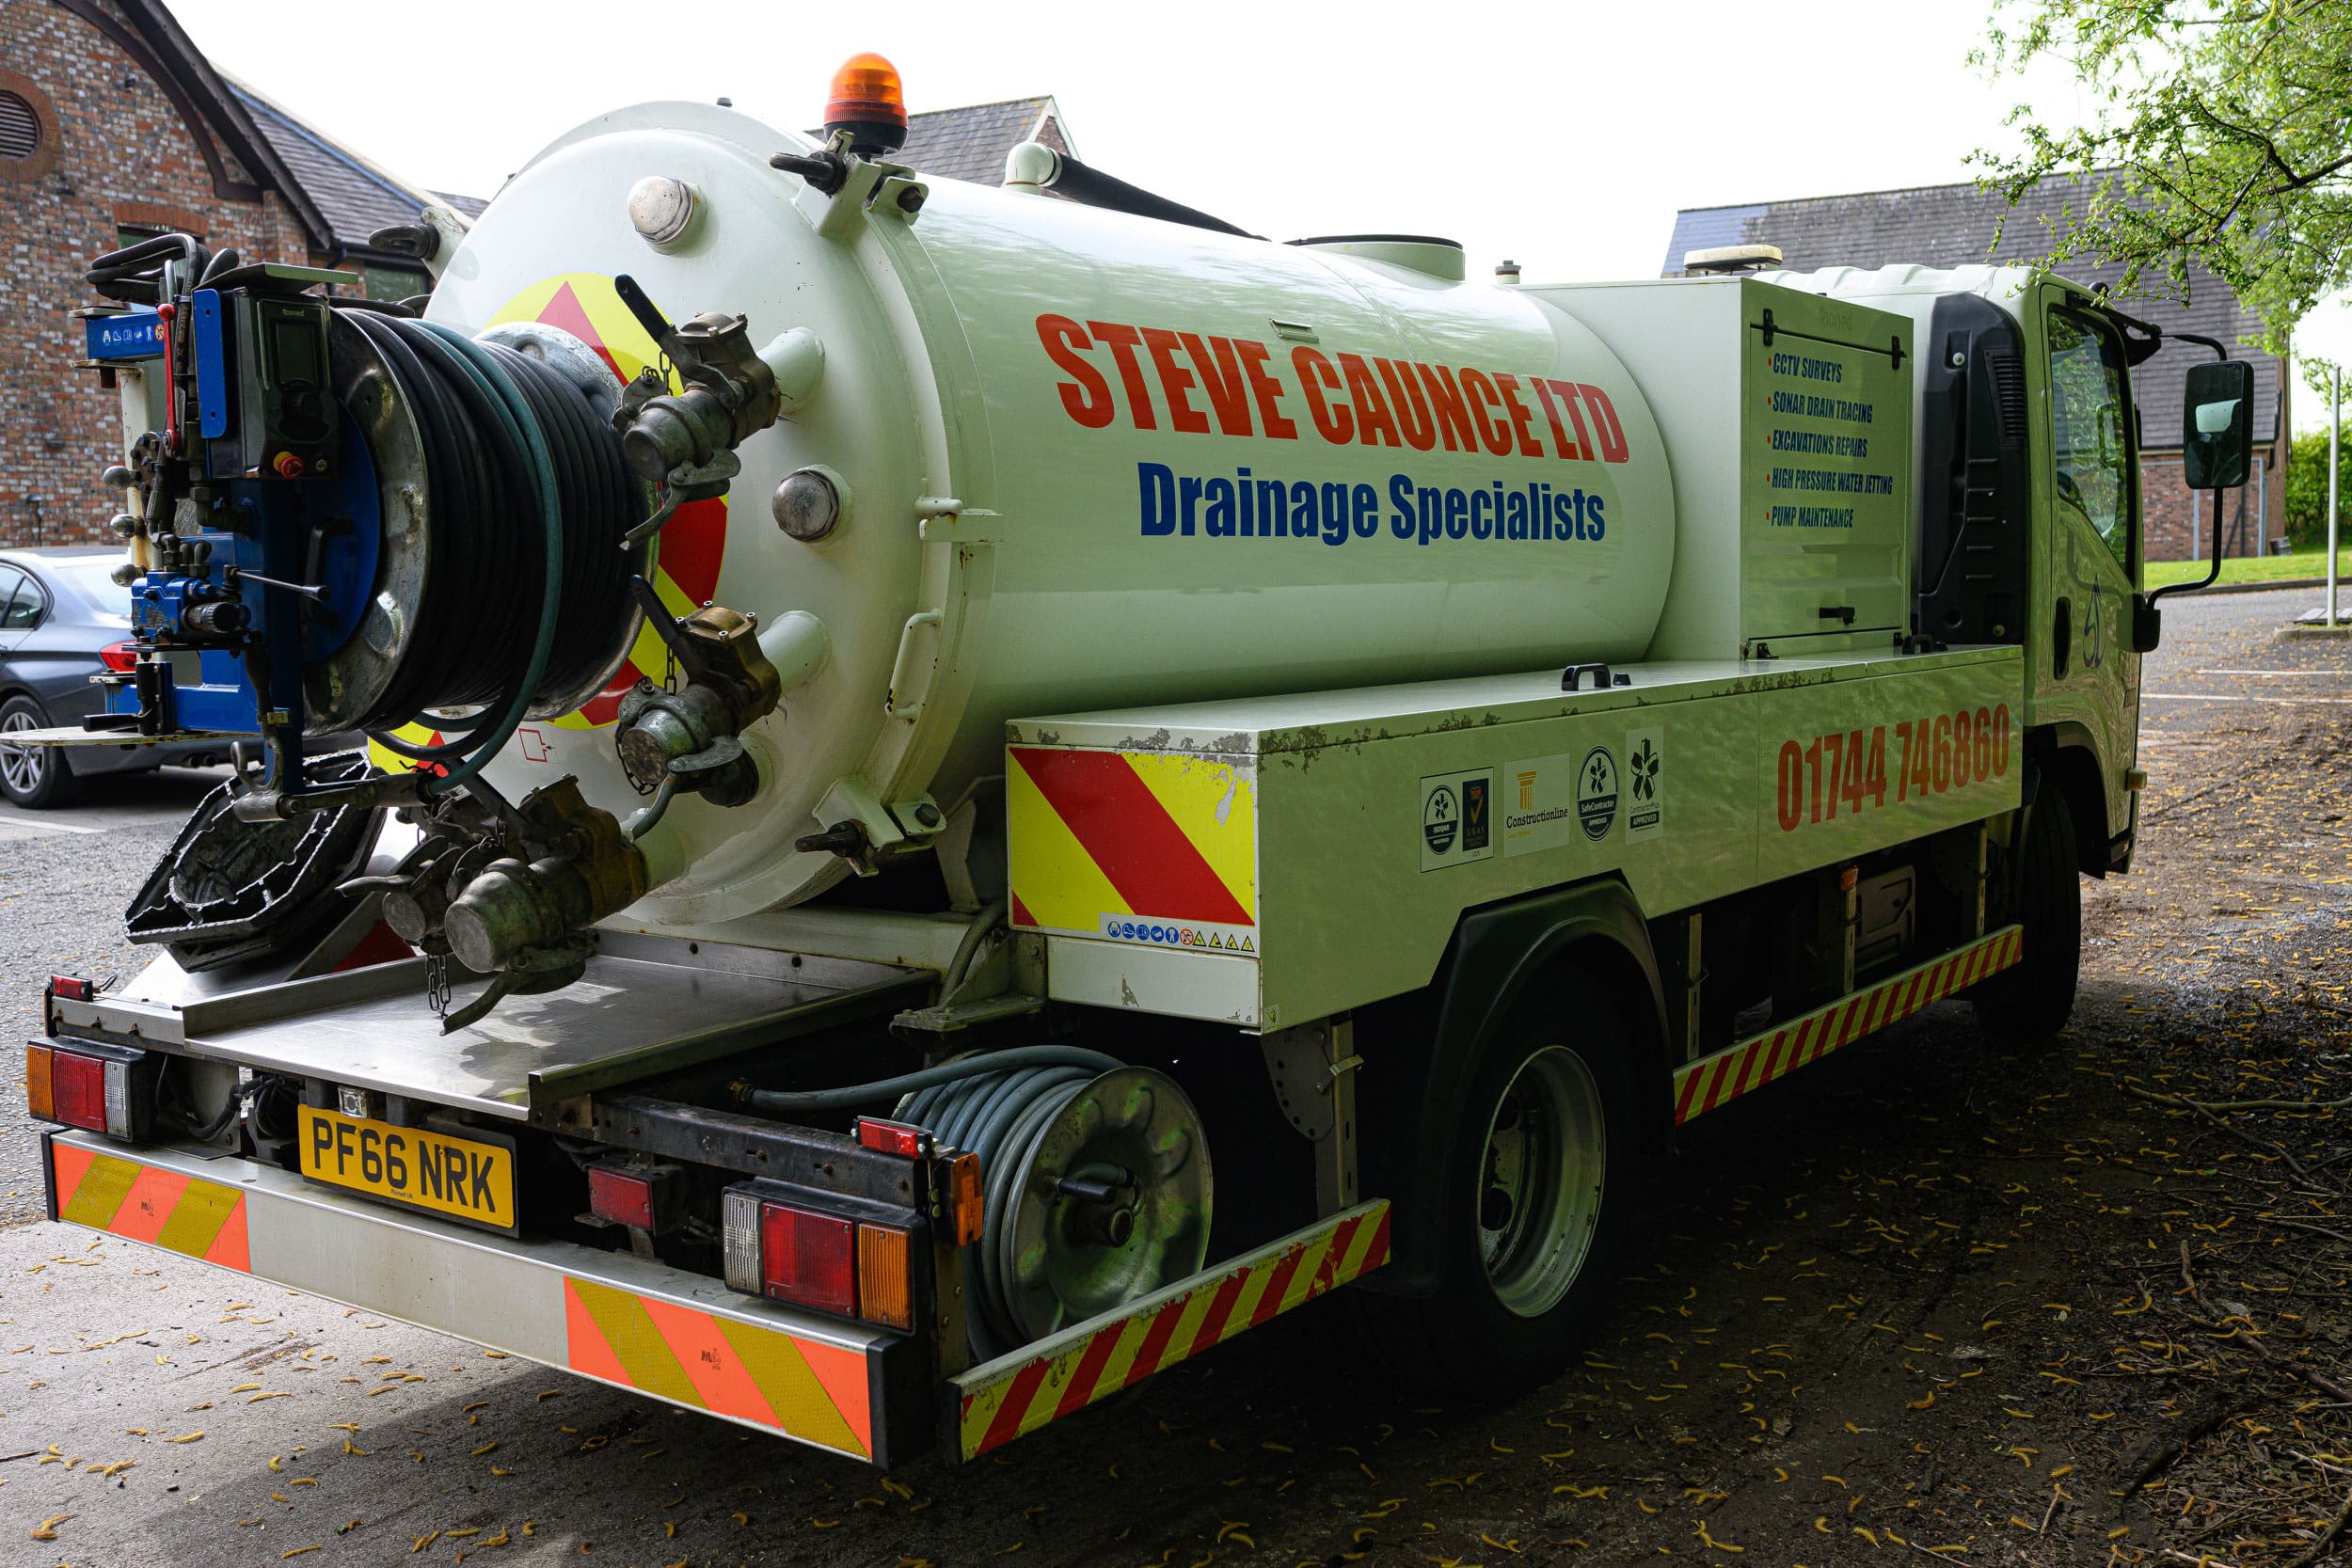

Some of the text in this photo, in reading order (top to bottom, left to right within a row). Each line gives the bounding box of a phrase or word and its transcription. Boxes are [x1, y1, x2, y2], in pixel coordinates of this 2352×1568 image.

[1772, 352, 1842, 383] CCTV SURVEYS
[1036, 314, 1629, 463] STEVE CAUNCE LTD
[1772, 391, 1872, 423] SONAR DRAIN TRACING
[1772, 430, 1867, 458] EXCAVATIONS REPAIRS
[1772, 467, 1893, 495] HIGH PRESSURE WATER JETTING
[1137, 462, 1605, 546] Drainage Specialists
[1772, 506, 1853, 529] PUMP MAINTENANCE
[1777, 703, 2010, 832] 01744 746860
[1506, 806, 1568, 829] Constructionline
[1632, 813, 1657, 826] APPROVED
[312, 1117, 496, 1213] PF66 NRK
